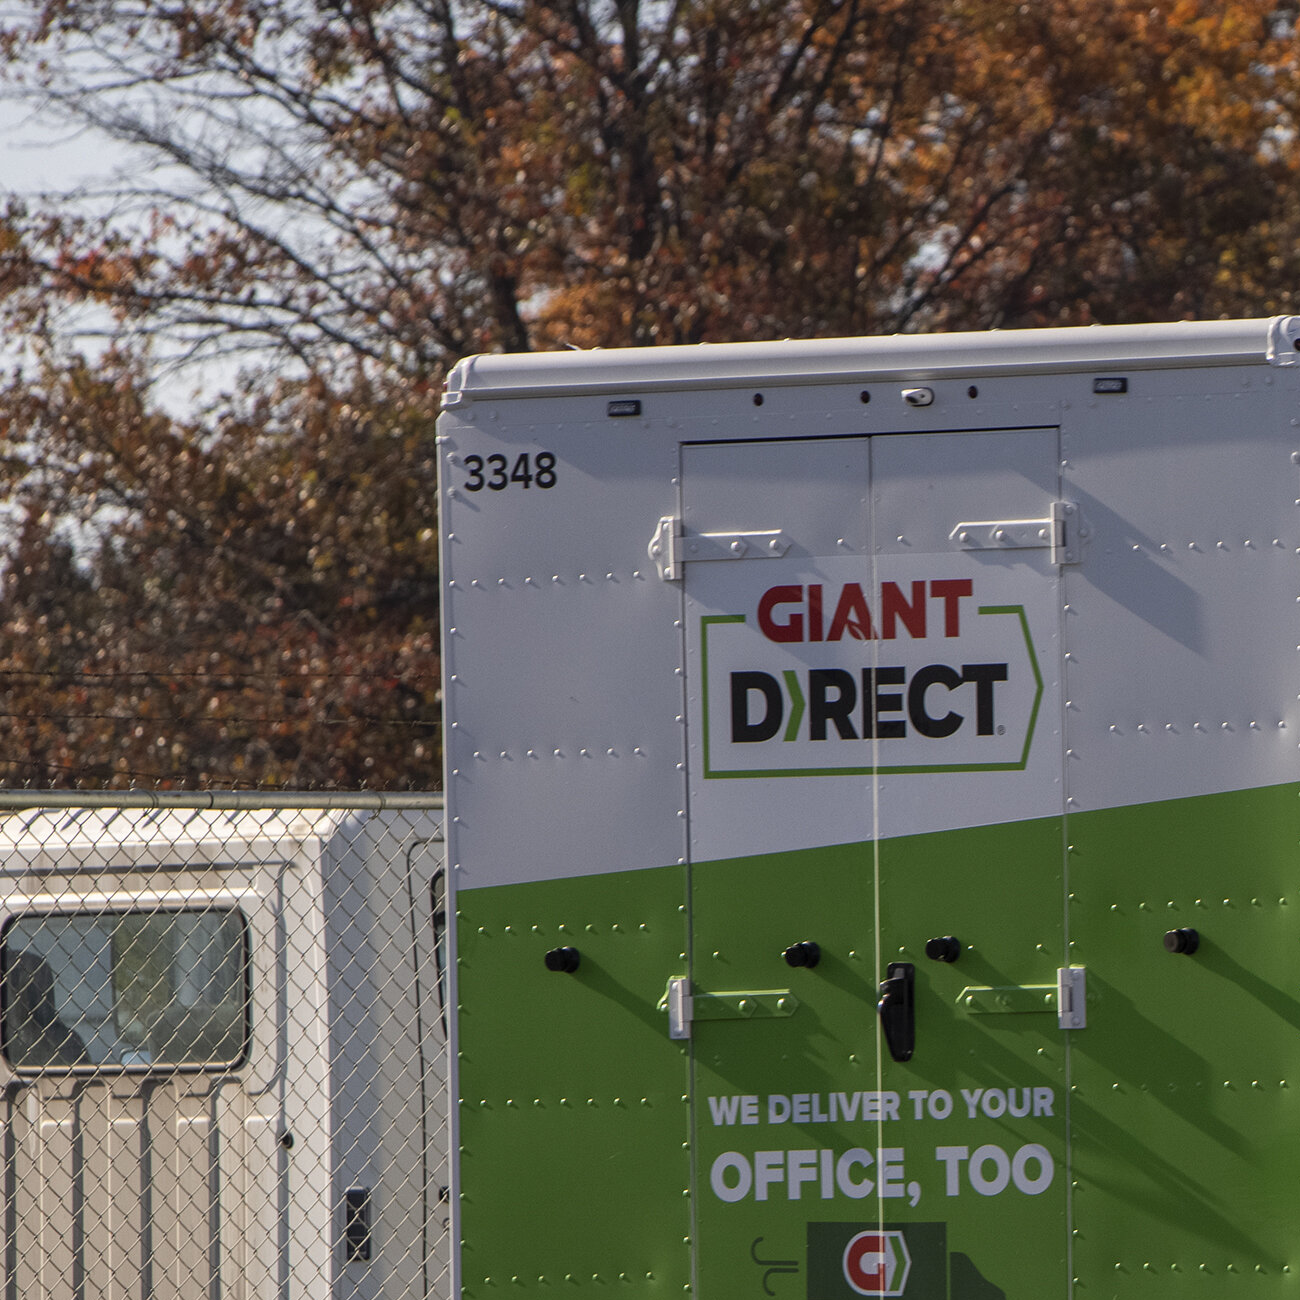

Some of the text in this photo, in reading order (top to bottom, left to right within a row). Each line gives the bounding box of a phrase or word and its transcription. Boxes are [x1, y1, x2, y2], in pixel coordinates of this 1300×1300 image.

[463, 452, 557, 492] 3348
[757, 579, 973, 643] GIANT
[708, 1086, 1055, 1127] WE DELIVER TO YOUR
[710, 1142, 1055, 1207] OFFICE, TOO
